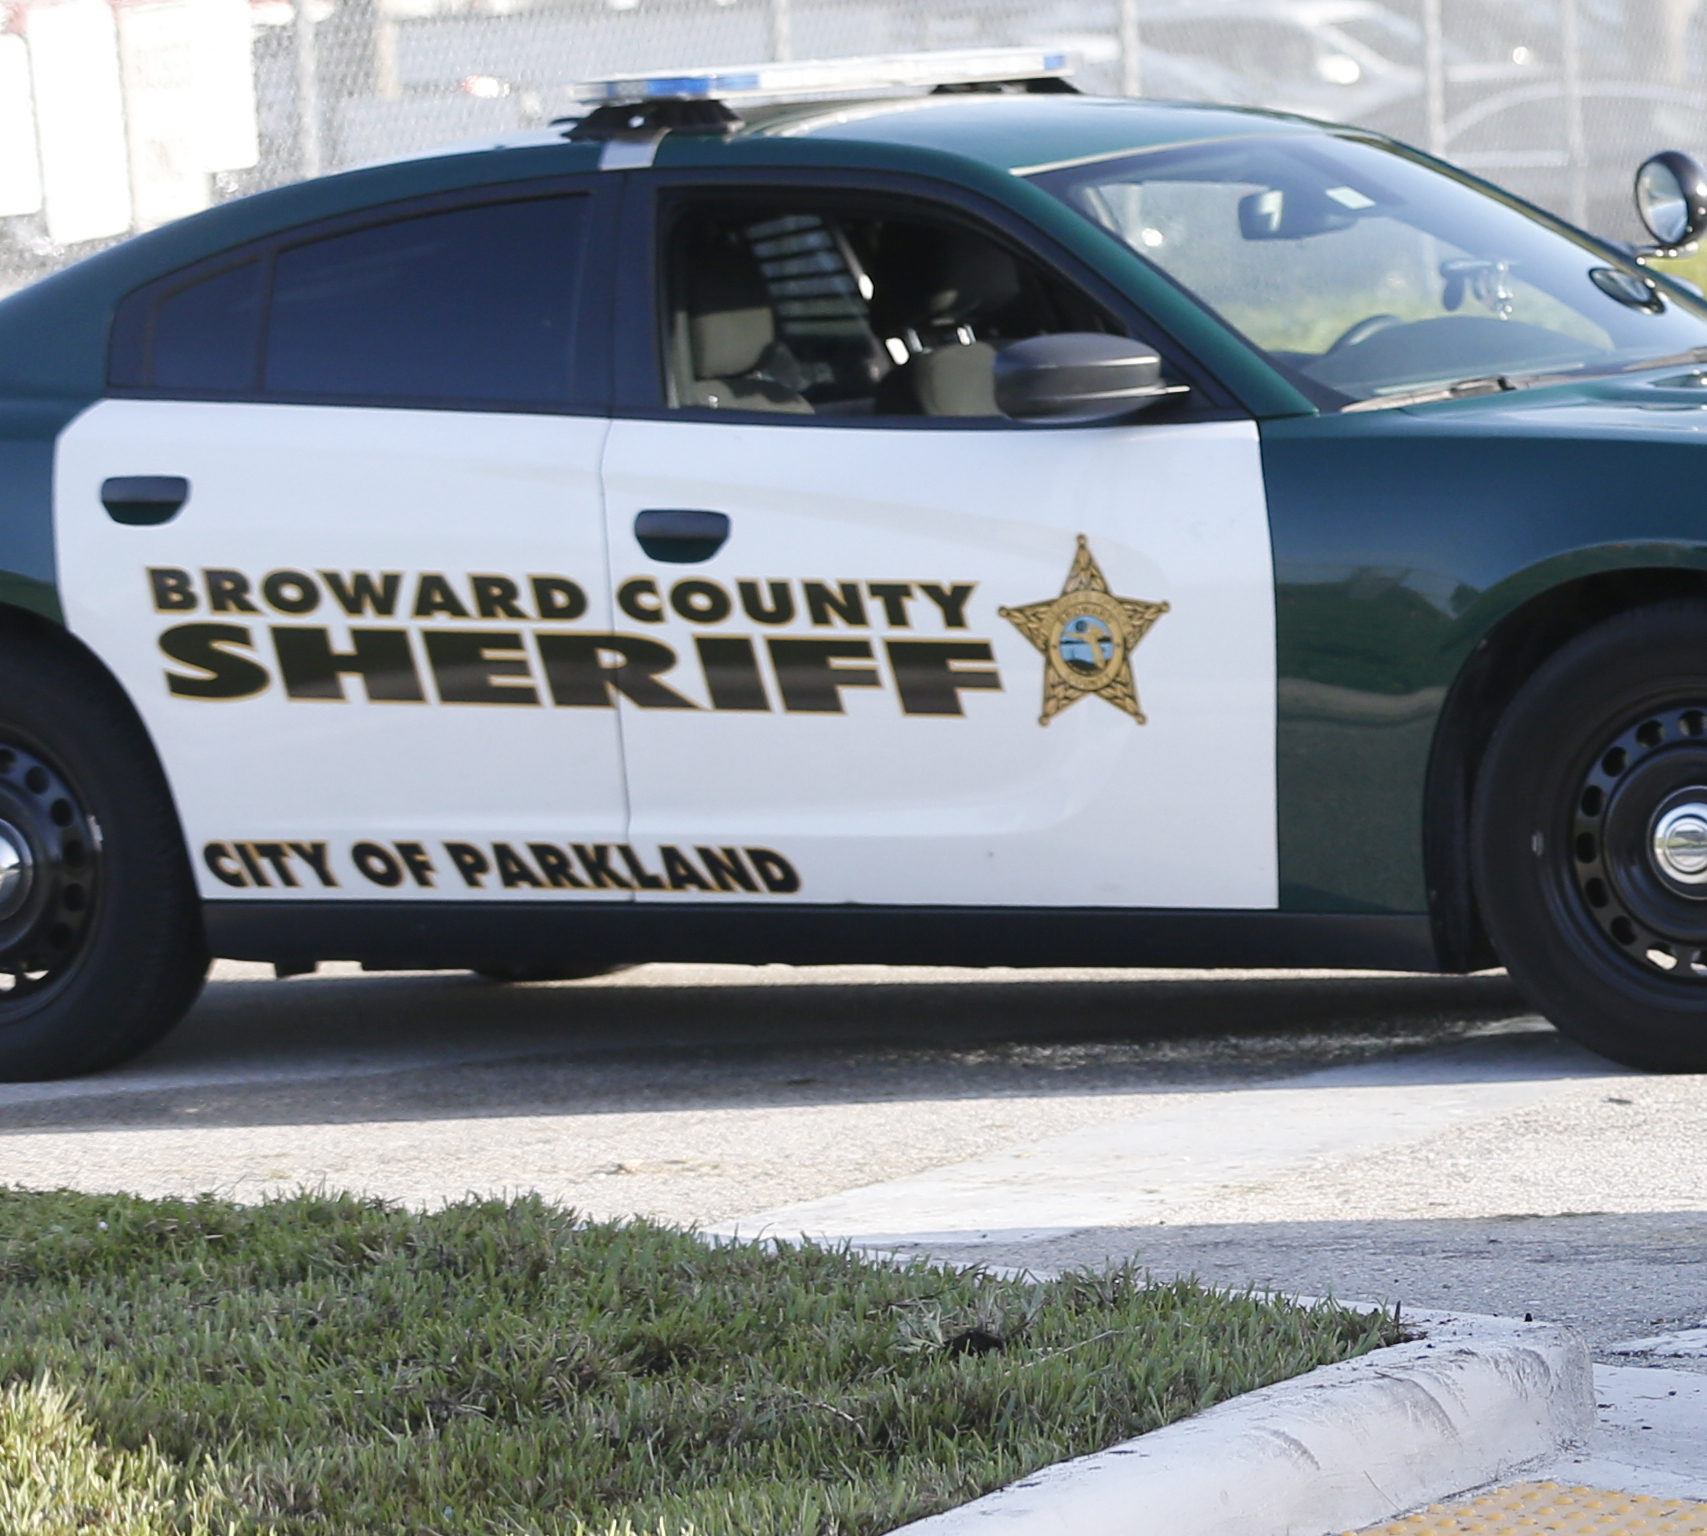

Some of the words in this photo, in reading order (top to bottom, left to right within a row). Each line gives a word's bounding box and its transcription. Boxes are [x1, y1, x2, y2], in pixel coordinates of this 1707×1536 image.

[144, 565, 591, 622] BROWARD
[614, 574, 980, 632] COUNTY
[154, 620, 1006, 720] SHERIFF
[201, 838, 332, 890] CITY
[356, 840, 437, 889] OF
[444, 840, 802, 895] PARKLAND
